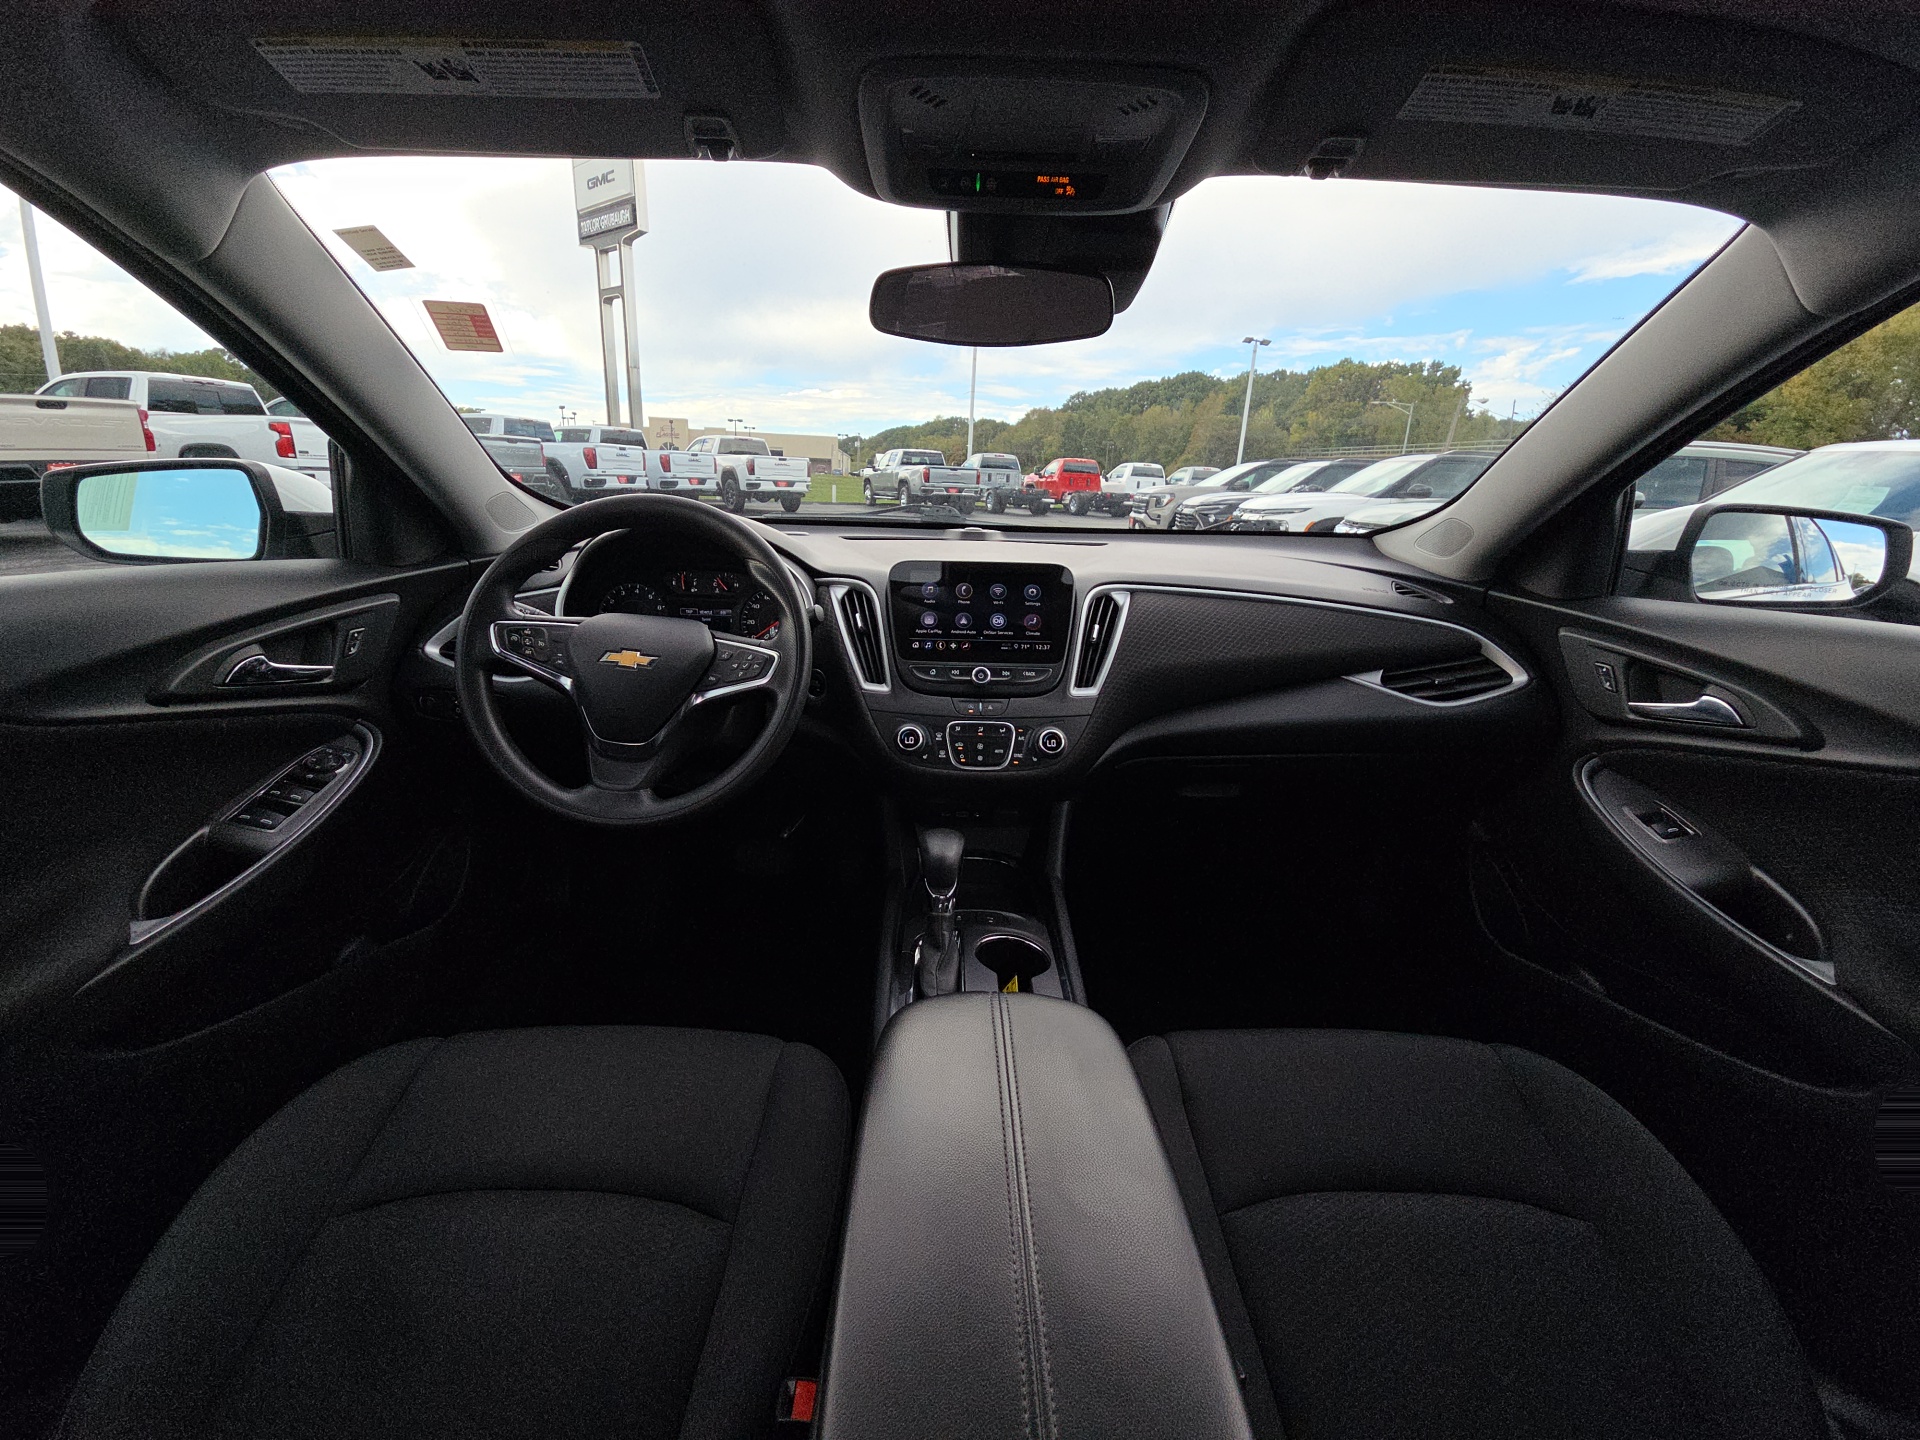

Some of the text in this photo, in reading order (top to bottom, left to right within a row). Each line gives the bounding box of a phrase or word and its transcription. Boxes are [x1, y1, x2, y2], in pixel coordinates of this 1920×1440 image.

[586, 169, 616, 190] GMC
[1059, 176, 1070, 184] BAG
[1055, 187, 1064, 195] OFF
[0, 418, 129, 428] EVROLET
[904, 736, 915, 744] LO
[1046, 739, 1057, 747] LO
